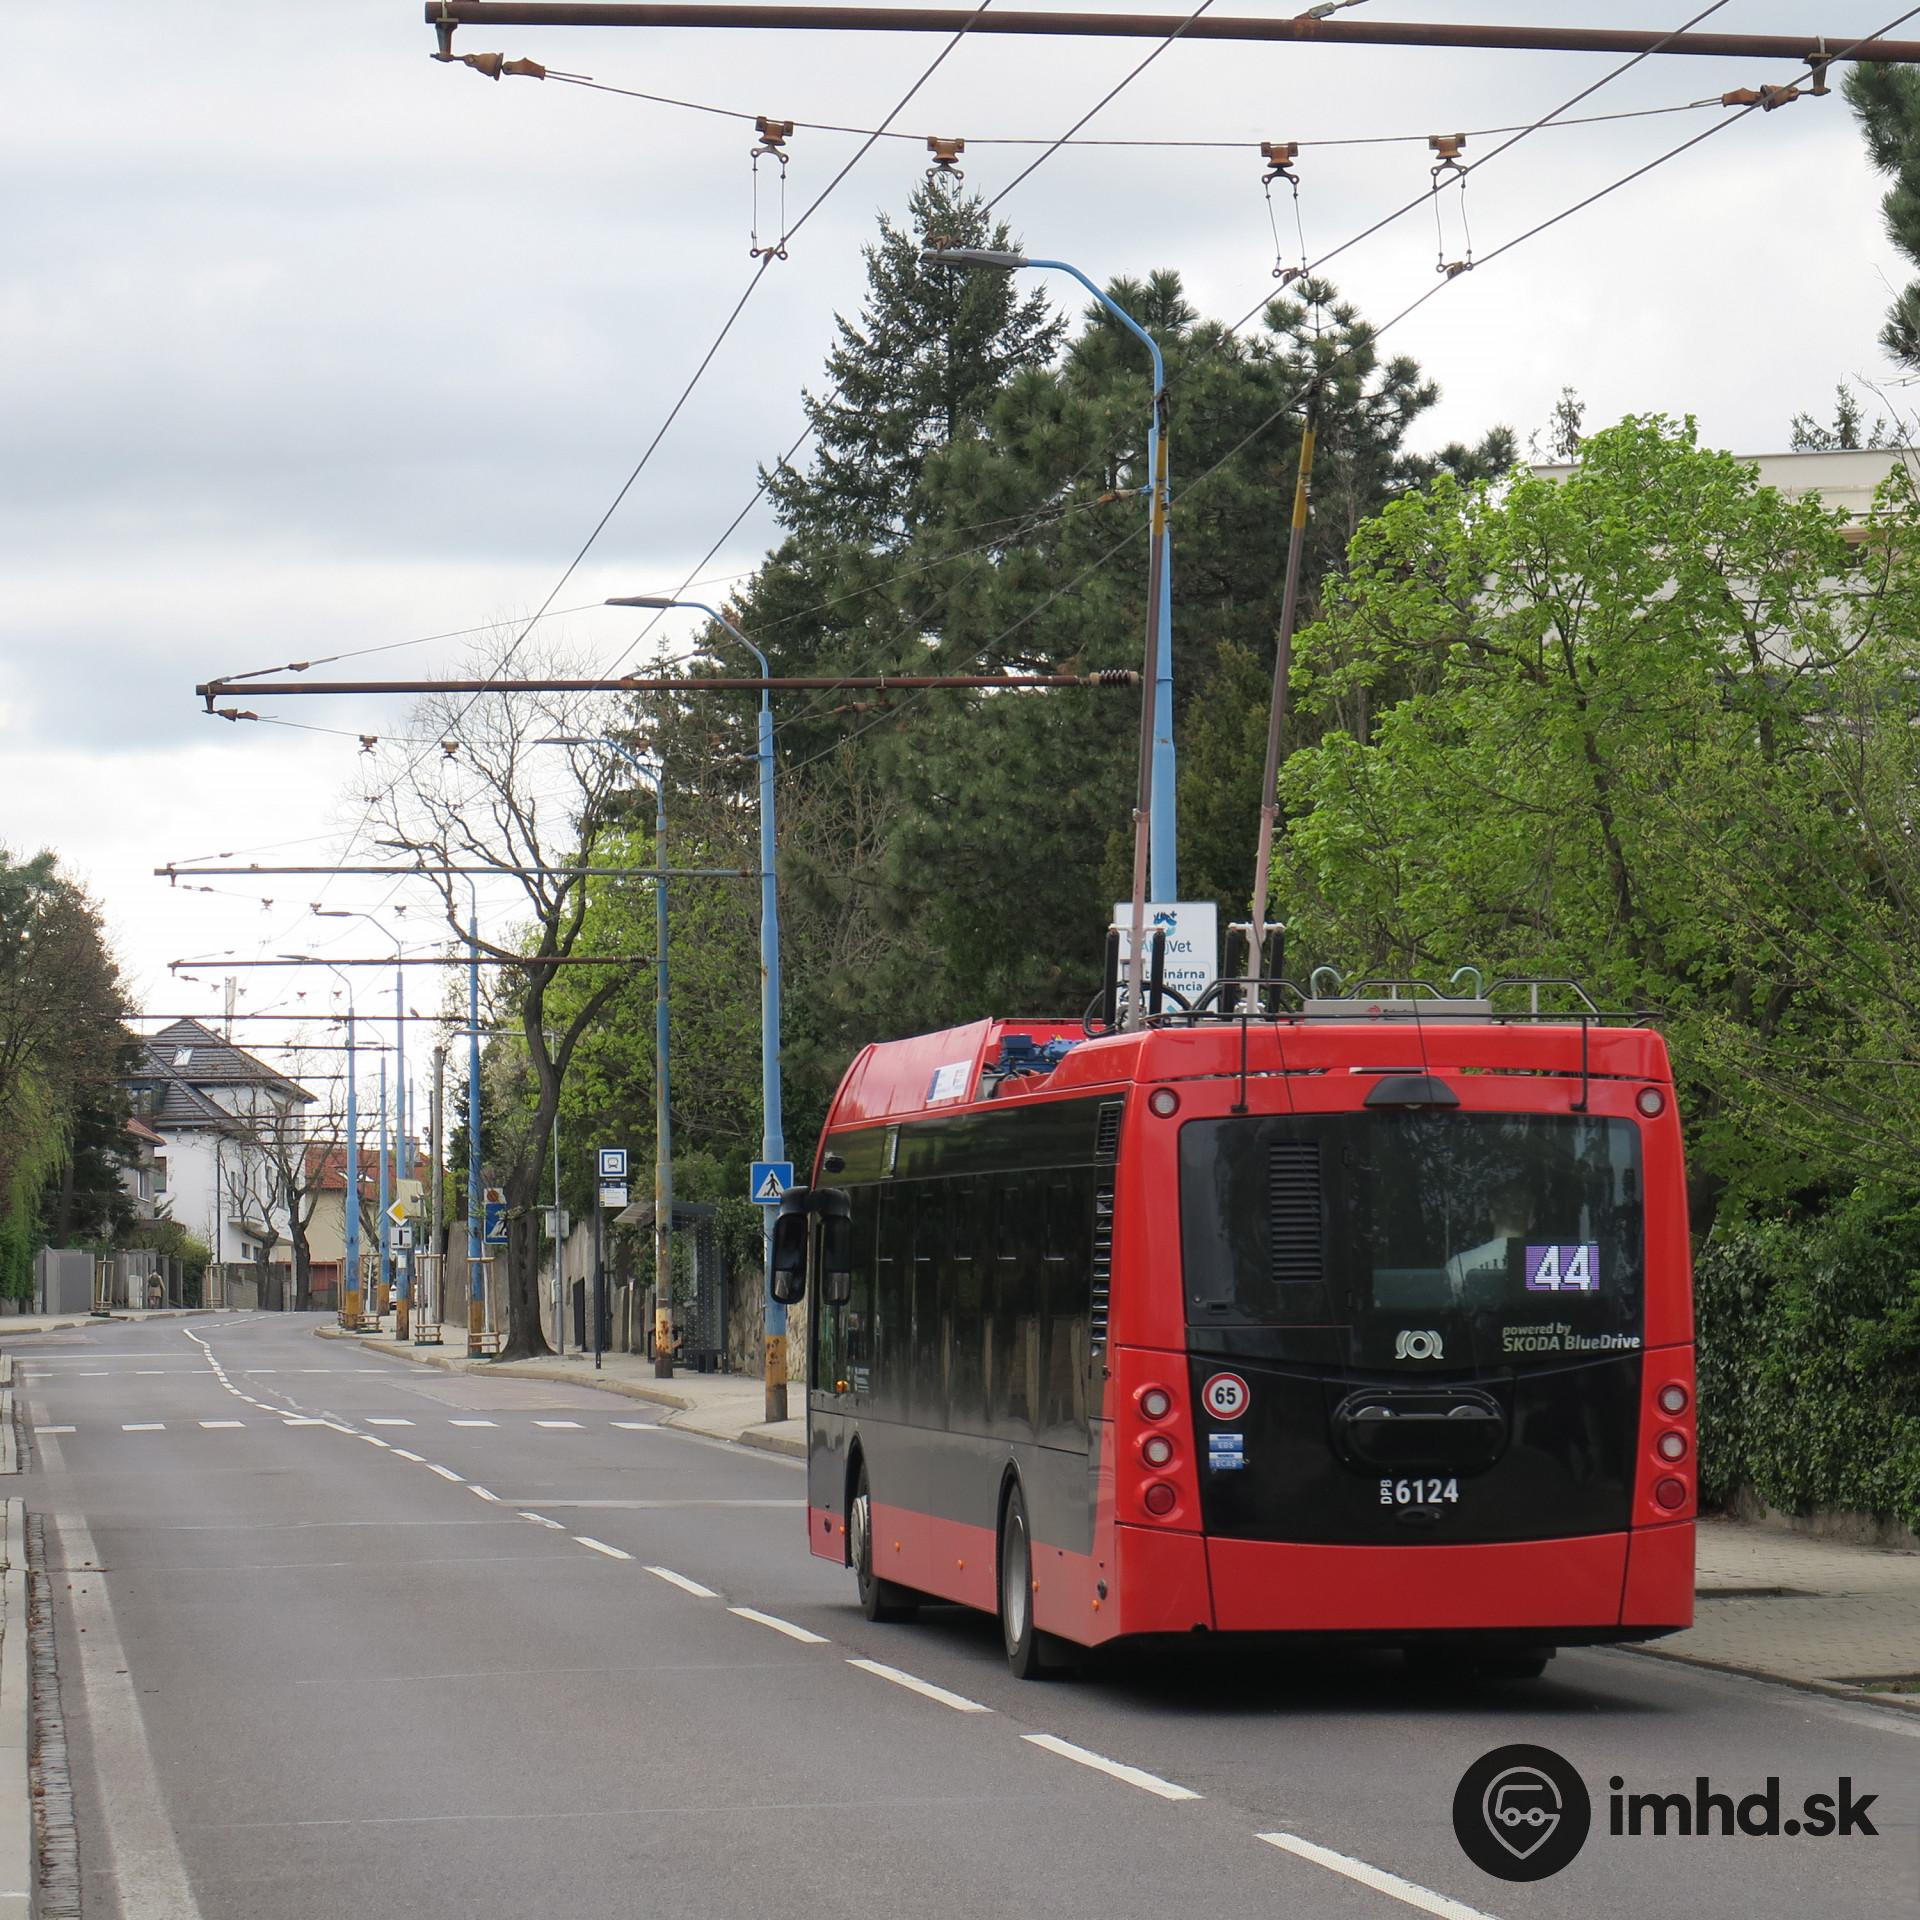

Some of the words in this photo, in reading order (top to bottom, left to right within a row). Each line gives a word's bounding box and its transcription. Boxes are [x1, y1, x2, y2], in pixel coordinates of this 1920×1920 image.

[1165, 981, 1203, 991] lancia
[1534, 1245, 1591, 1290] 44
[1502, 1323, 1554, 1338] powered
[1556, 1322, 1572, 1336] by
[1564, 1334, 1641, 1350] BlueDrive
[1215, 1386, 1236, 1405] 65
[1380, 1479, 1392, 1504] DPB
[1395, 1478, 1459, 1504] 6124
